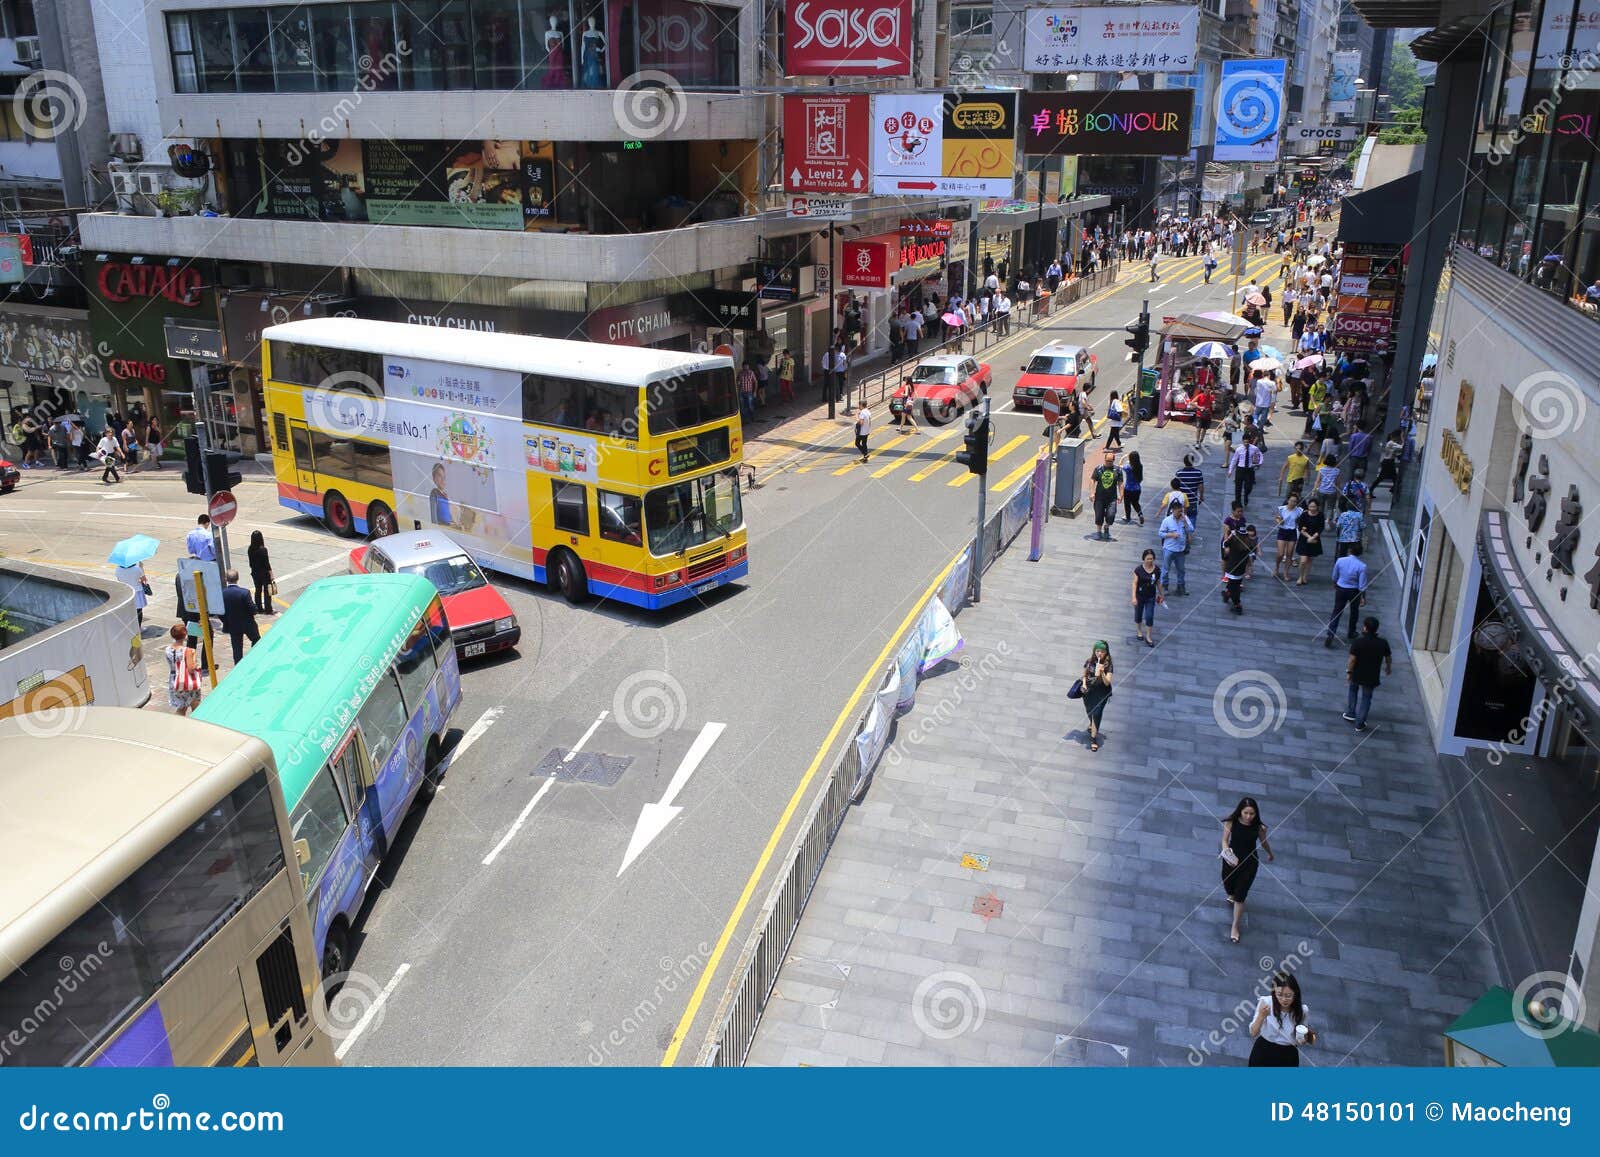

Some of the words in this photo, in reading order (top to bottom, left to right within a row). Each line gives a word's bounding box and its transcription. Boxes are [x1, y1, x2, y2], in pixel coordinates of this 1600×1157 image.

[794, 1, 900, 49] Sasa
[1085, 112, 1179, 135] BONJOUR
[1300, 127, 1342, 139] crocs
[808, 168, 835, 179] Level
[837, 169, 844, 180] 2
[608, 319, 635, 341] CITY
[637, 311, 671, 332] CHAIN
[1337, 317, 1372, 332] Sasa
